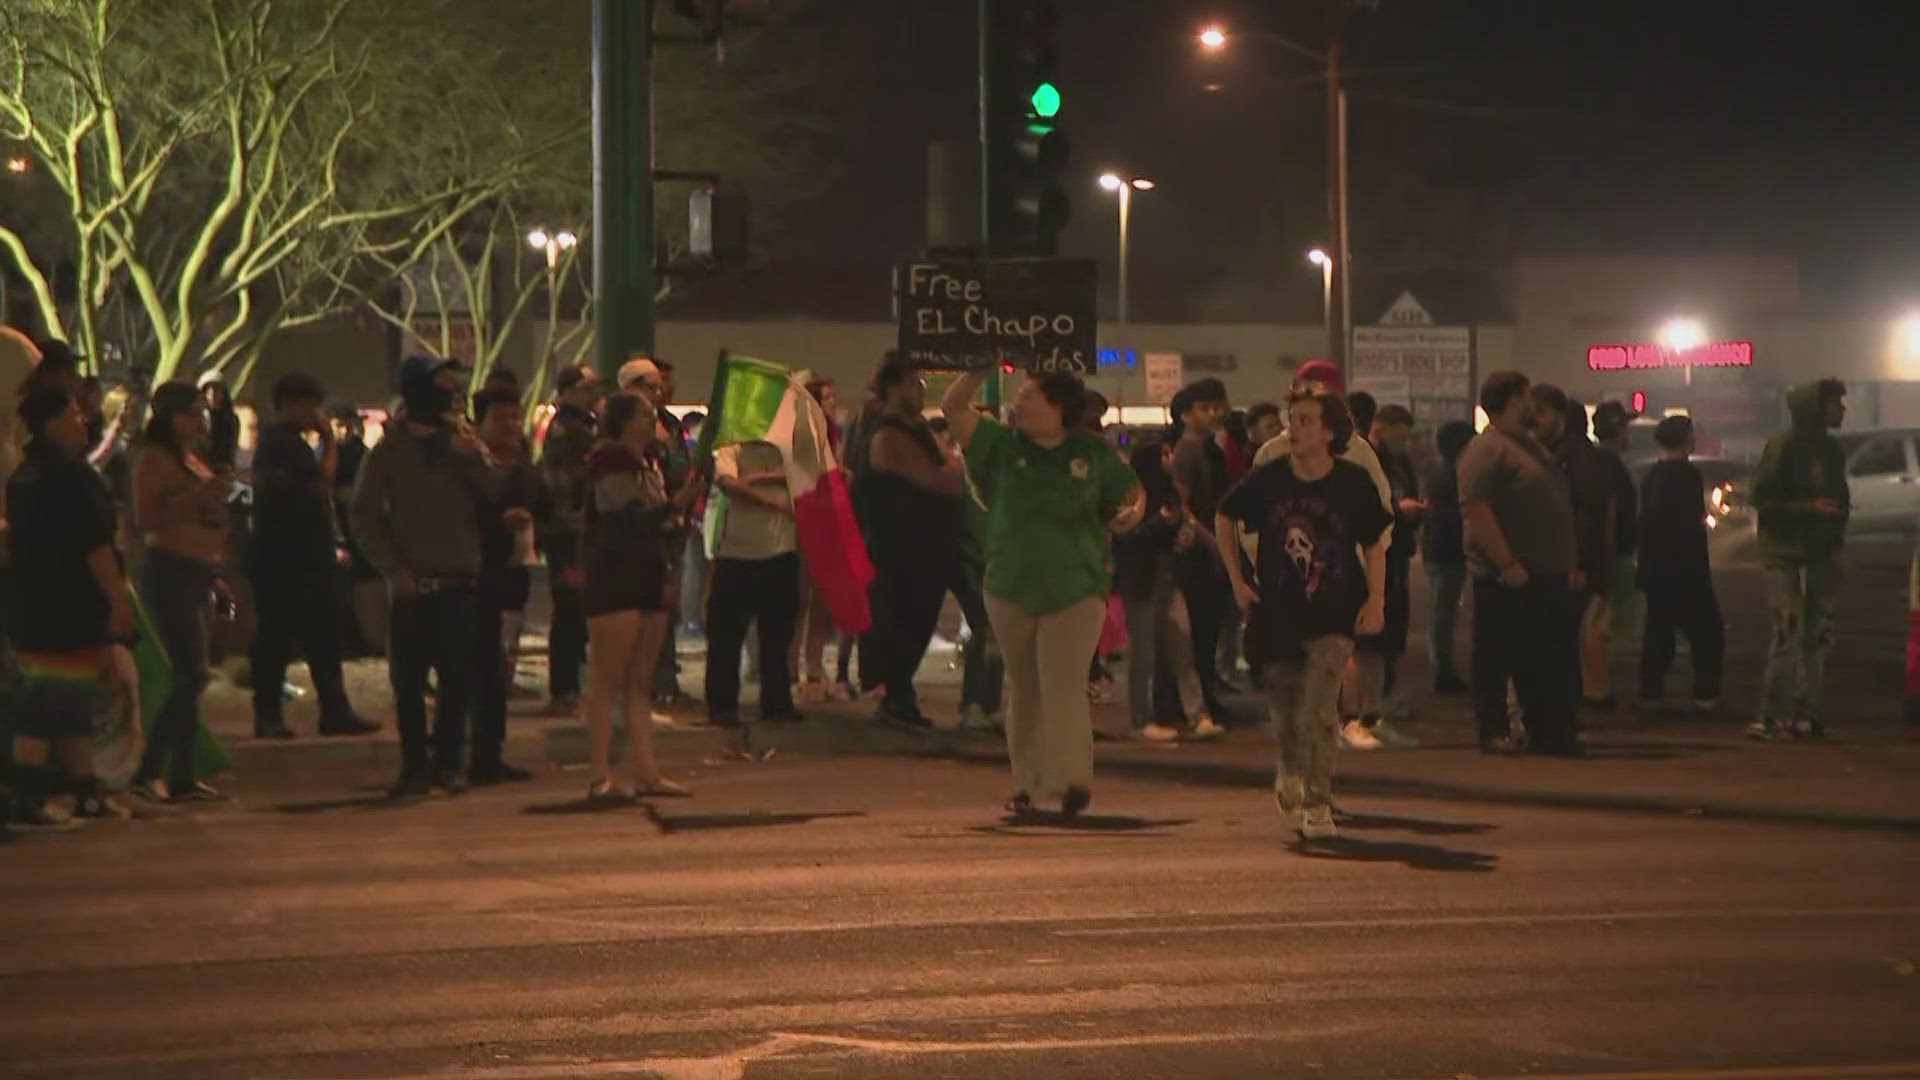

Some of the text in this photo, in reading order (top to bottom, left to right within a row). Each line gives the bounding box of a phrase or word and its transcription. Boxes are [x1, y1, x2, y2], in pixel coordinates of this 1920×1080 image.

[910, 264, 983, 301] Free
[917, 305, 1075, 348] EL Chapo
